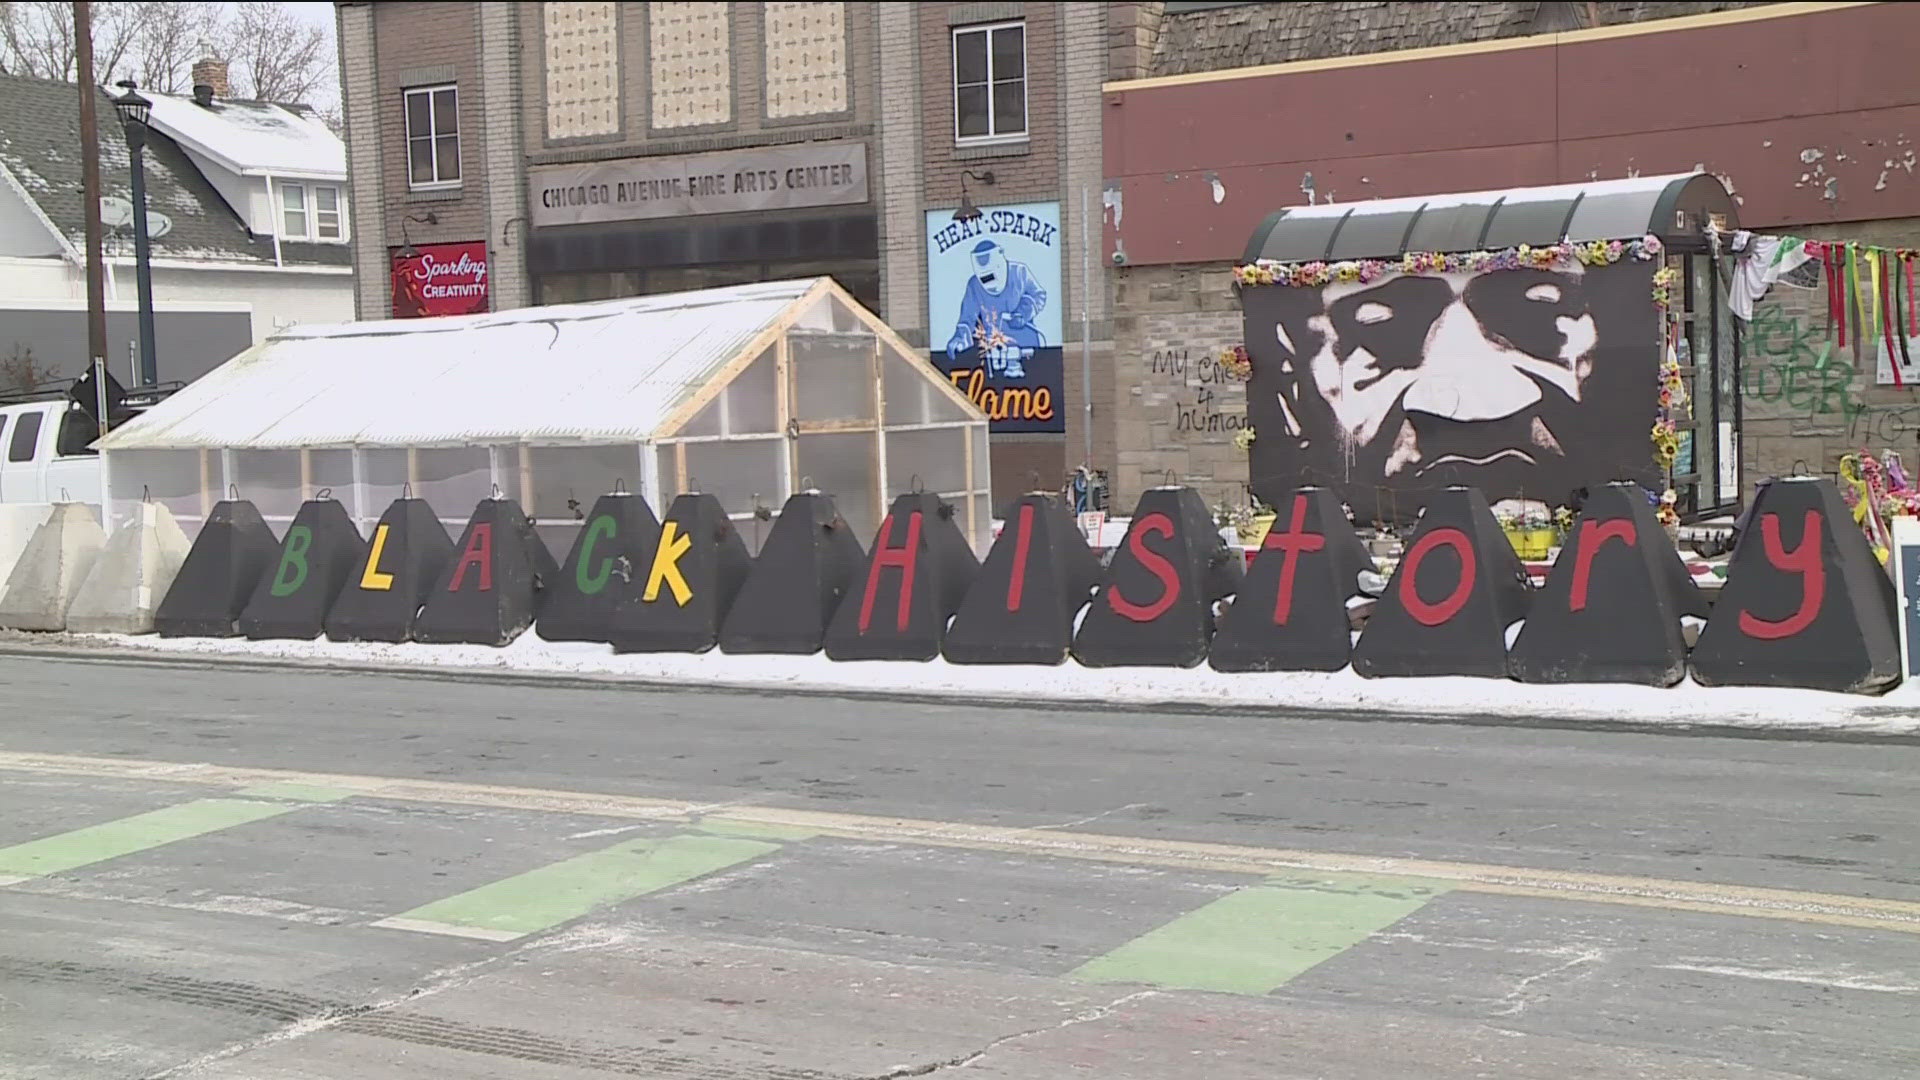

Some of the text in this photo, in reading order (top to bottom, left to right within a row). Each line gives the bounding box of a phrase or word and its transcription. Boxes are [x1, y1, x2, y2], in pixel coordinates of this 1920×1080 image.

[542, 163, 853, 208] CHICAGO AVENUE FIRE ARTS CENTER
[414, 252, 486, 283] Sparking
[423, 284, 486, 298] CREATIVITY
[270, 515, 694, 608] BLACK
